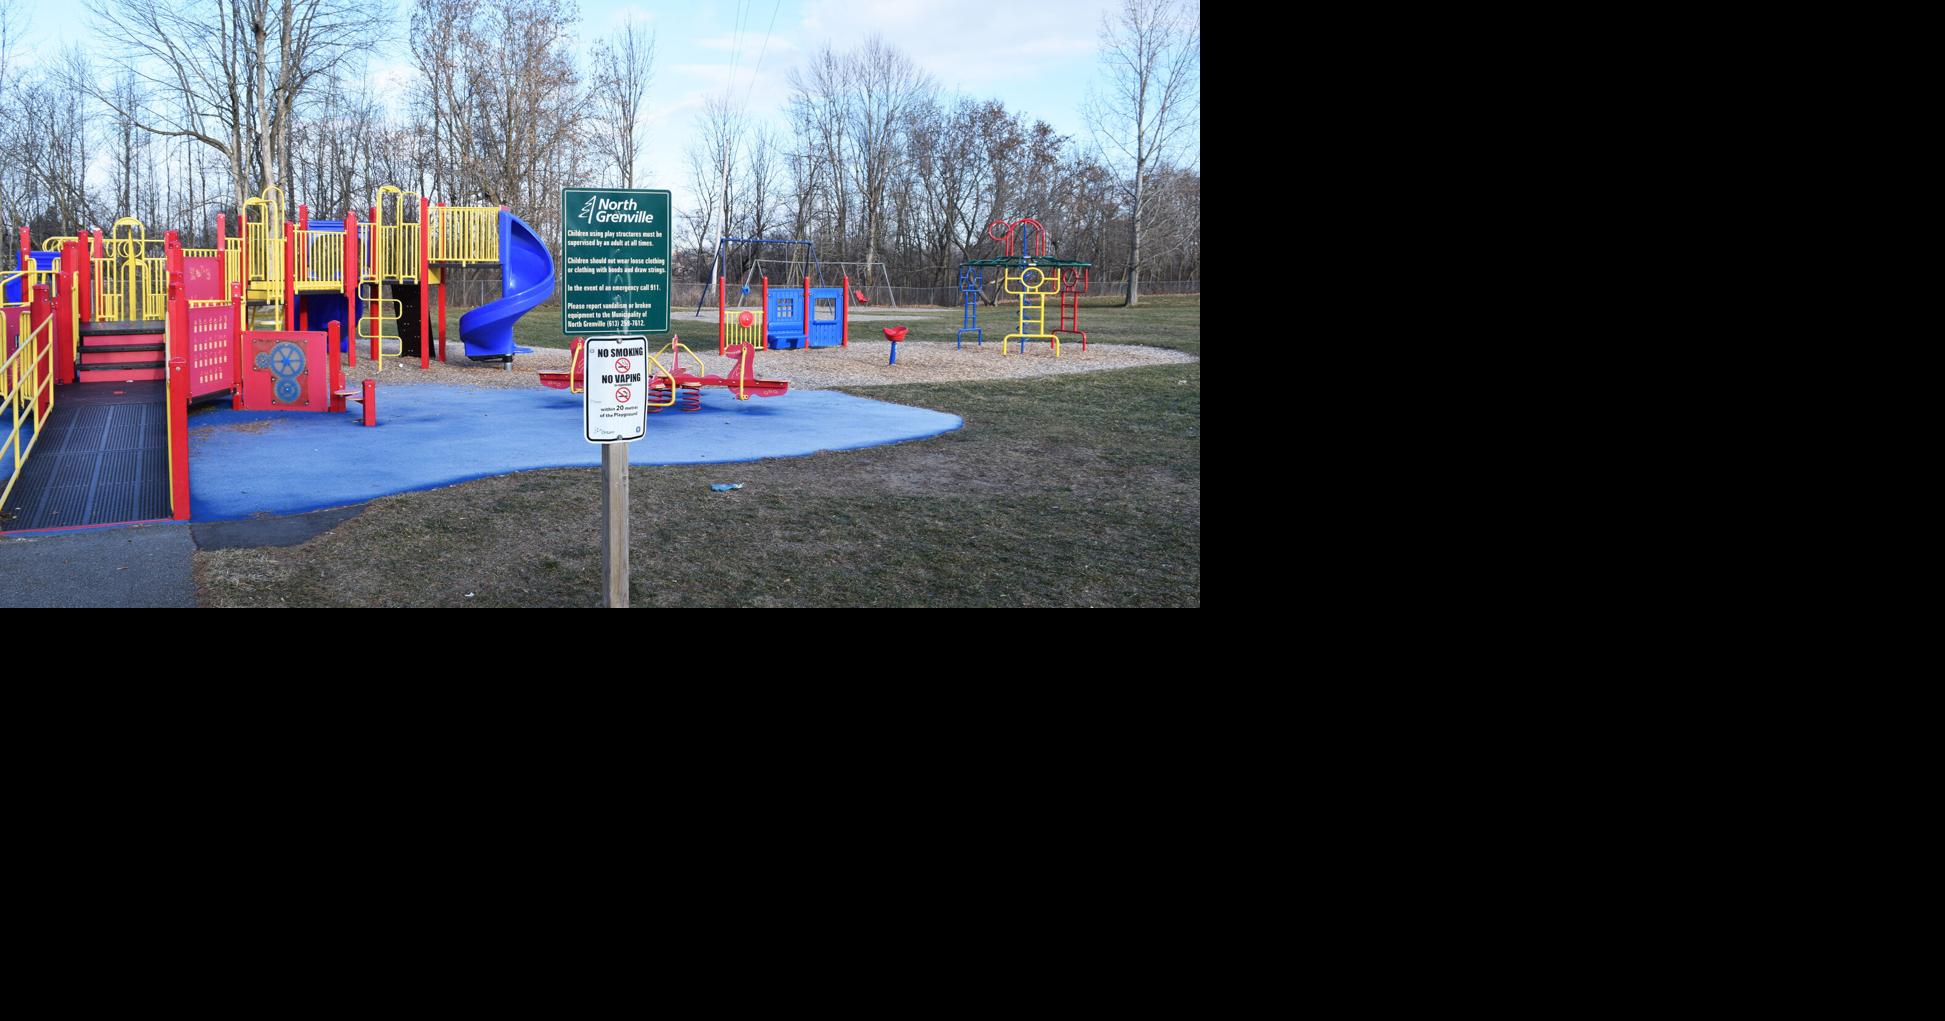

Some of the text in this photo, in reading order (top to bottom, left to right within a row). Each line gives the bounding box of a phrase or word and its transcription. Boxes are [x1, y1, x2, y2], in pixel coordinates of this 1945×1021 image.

[598, 199, 637, 210] North
[596, 211, 653, 223] Grenville
[598, 347, 643, 358] NO SMOKING
[602, 373, 640, 384] NO VAPING
